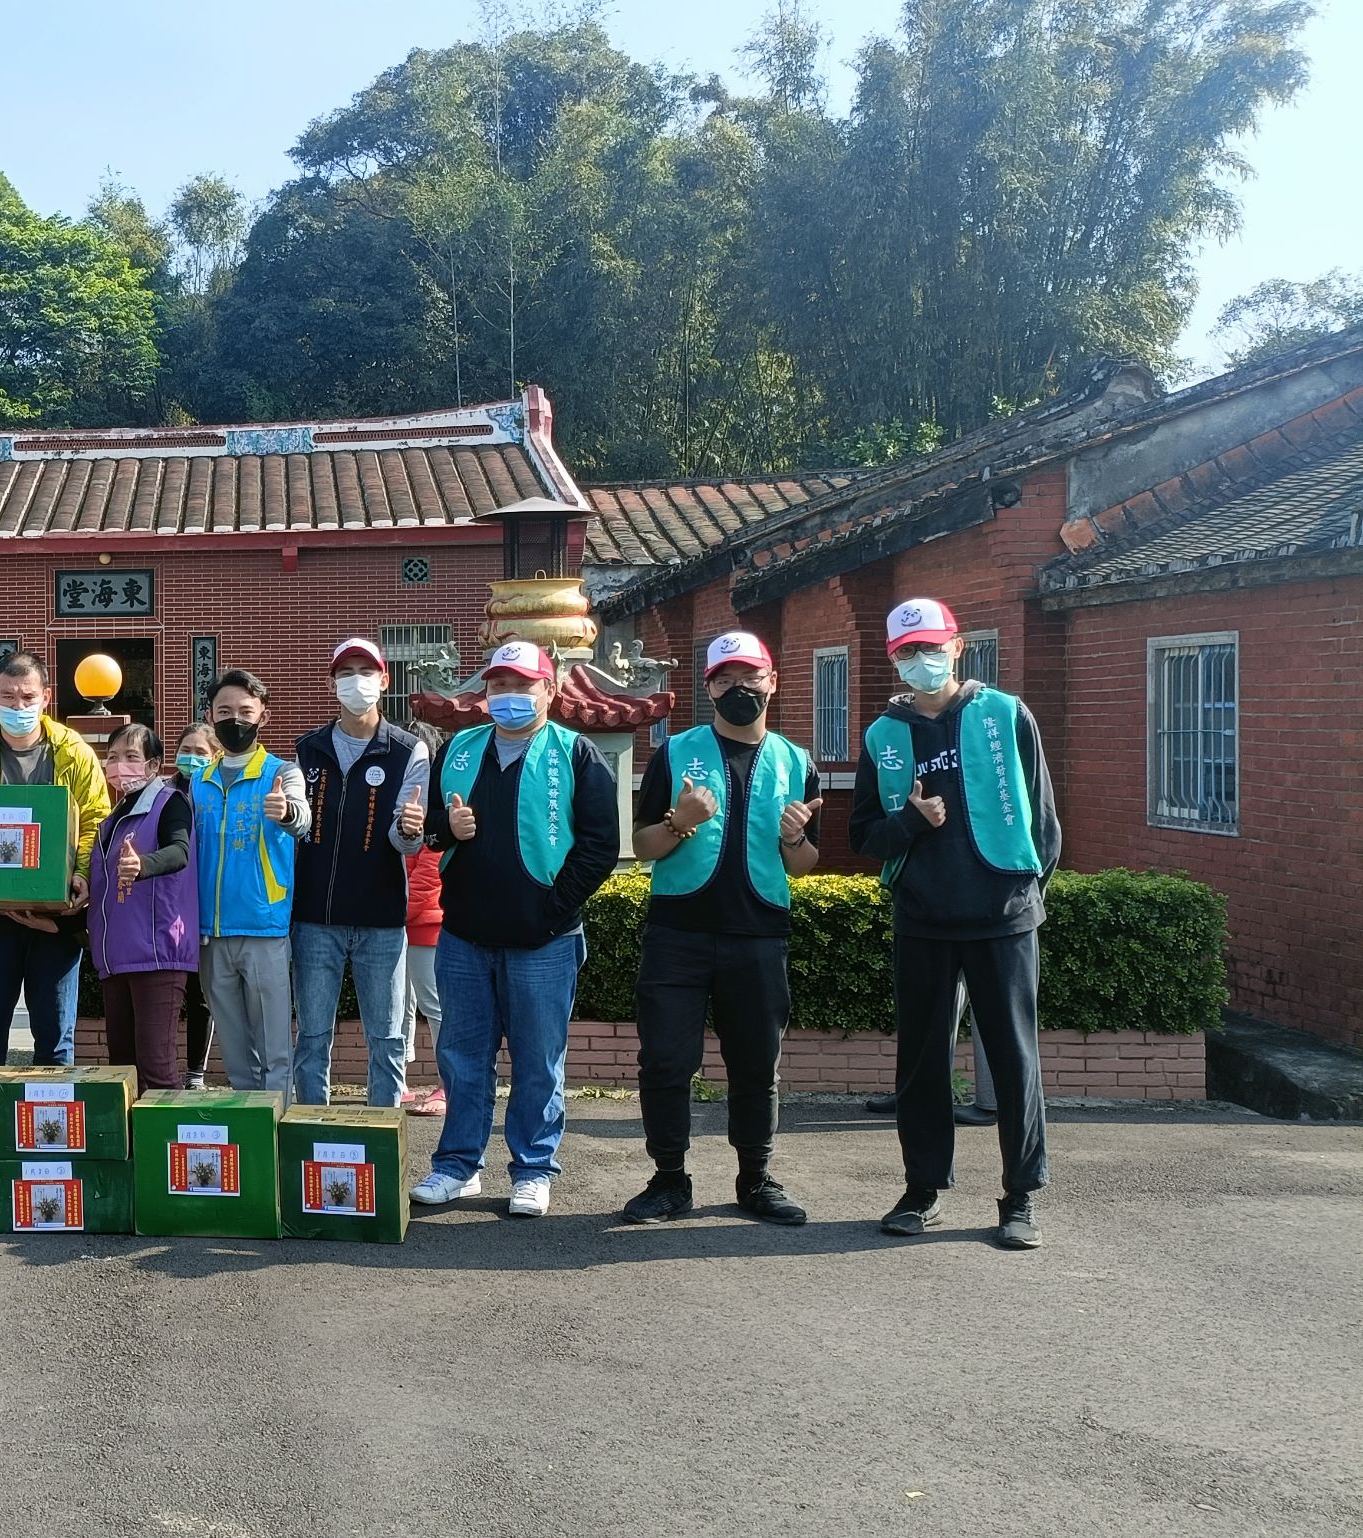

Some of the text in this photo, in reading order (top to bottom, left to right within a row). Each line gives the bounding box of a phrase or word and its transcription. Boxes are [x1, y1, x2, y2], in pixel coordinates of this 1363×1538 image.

[196, 646, 214, 723] 東海家聲
[547, 748, 559, 847] 隆祥經濟發展基金會
[681, 757, 709, 780] 志
[878, 745, 905, 812] 志工
[982, 716, 1015, 826] 隆祥經濟發展基金會
